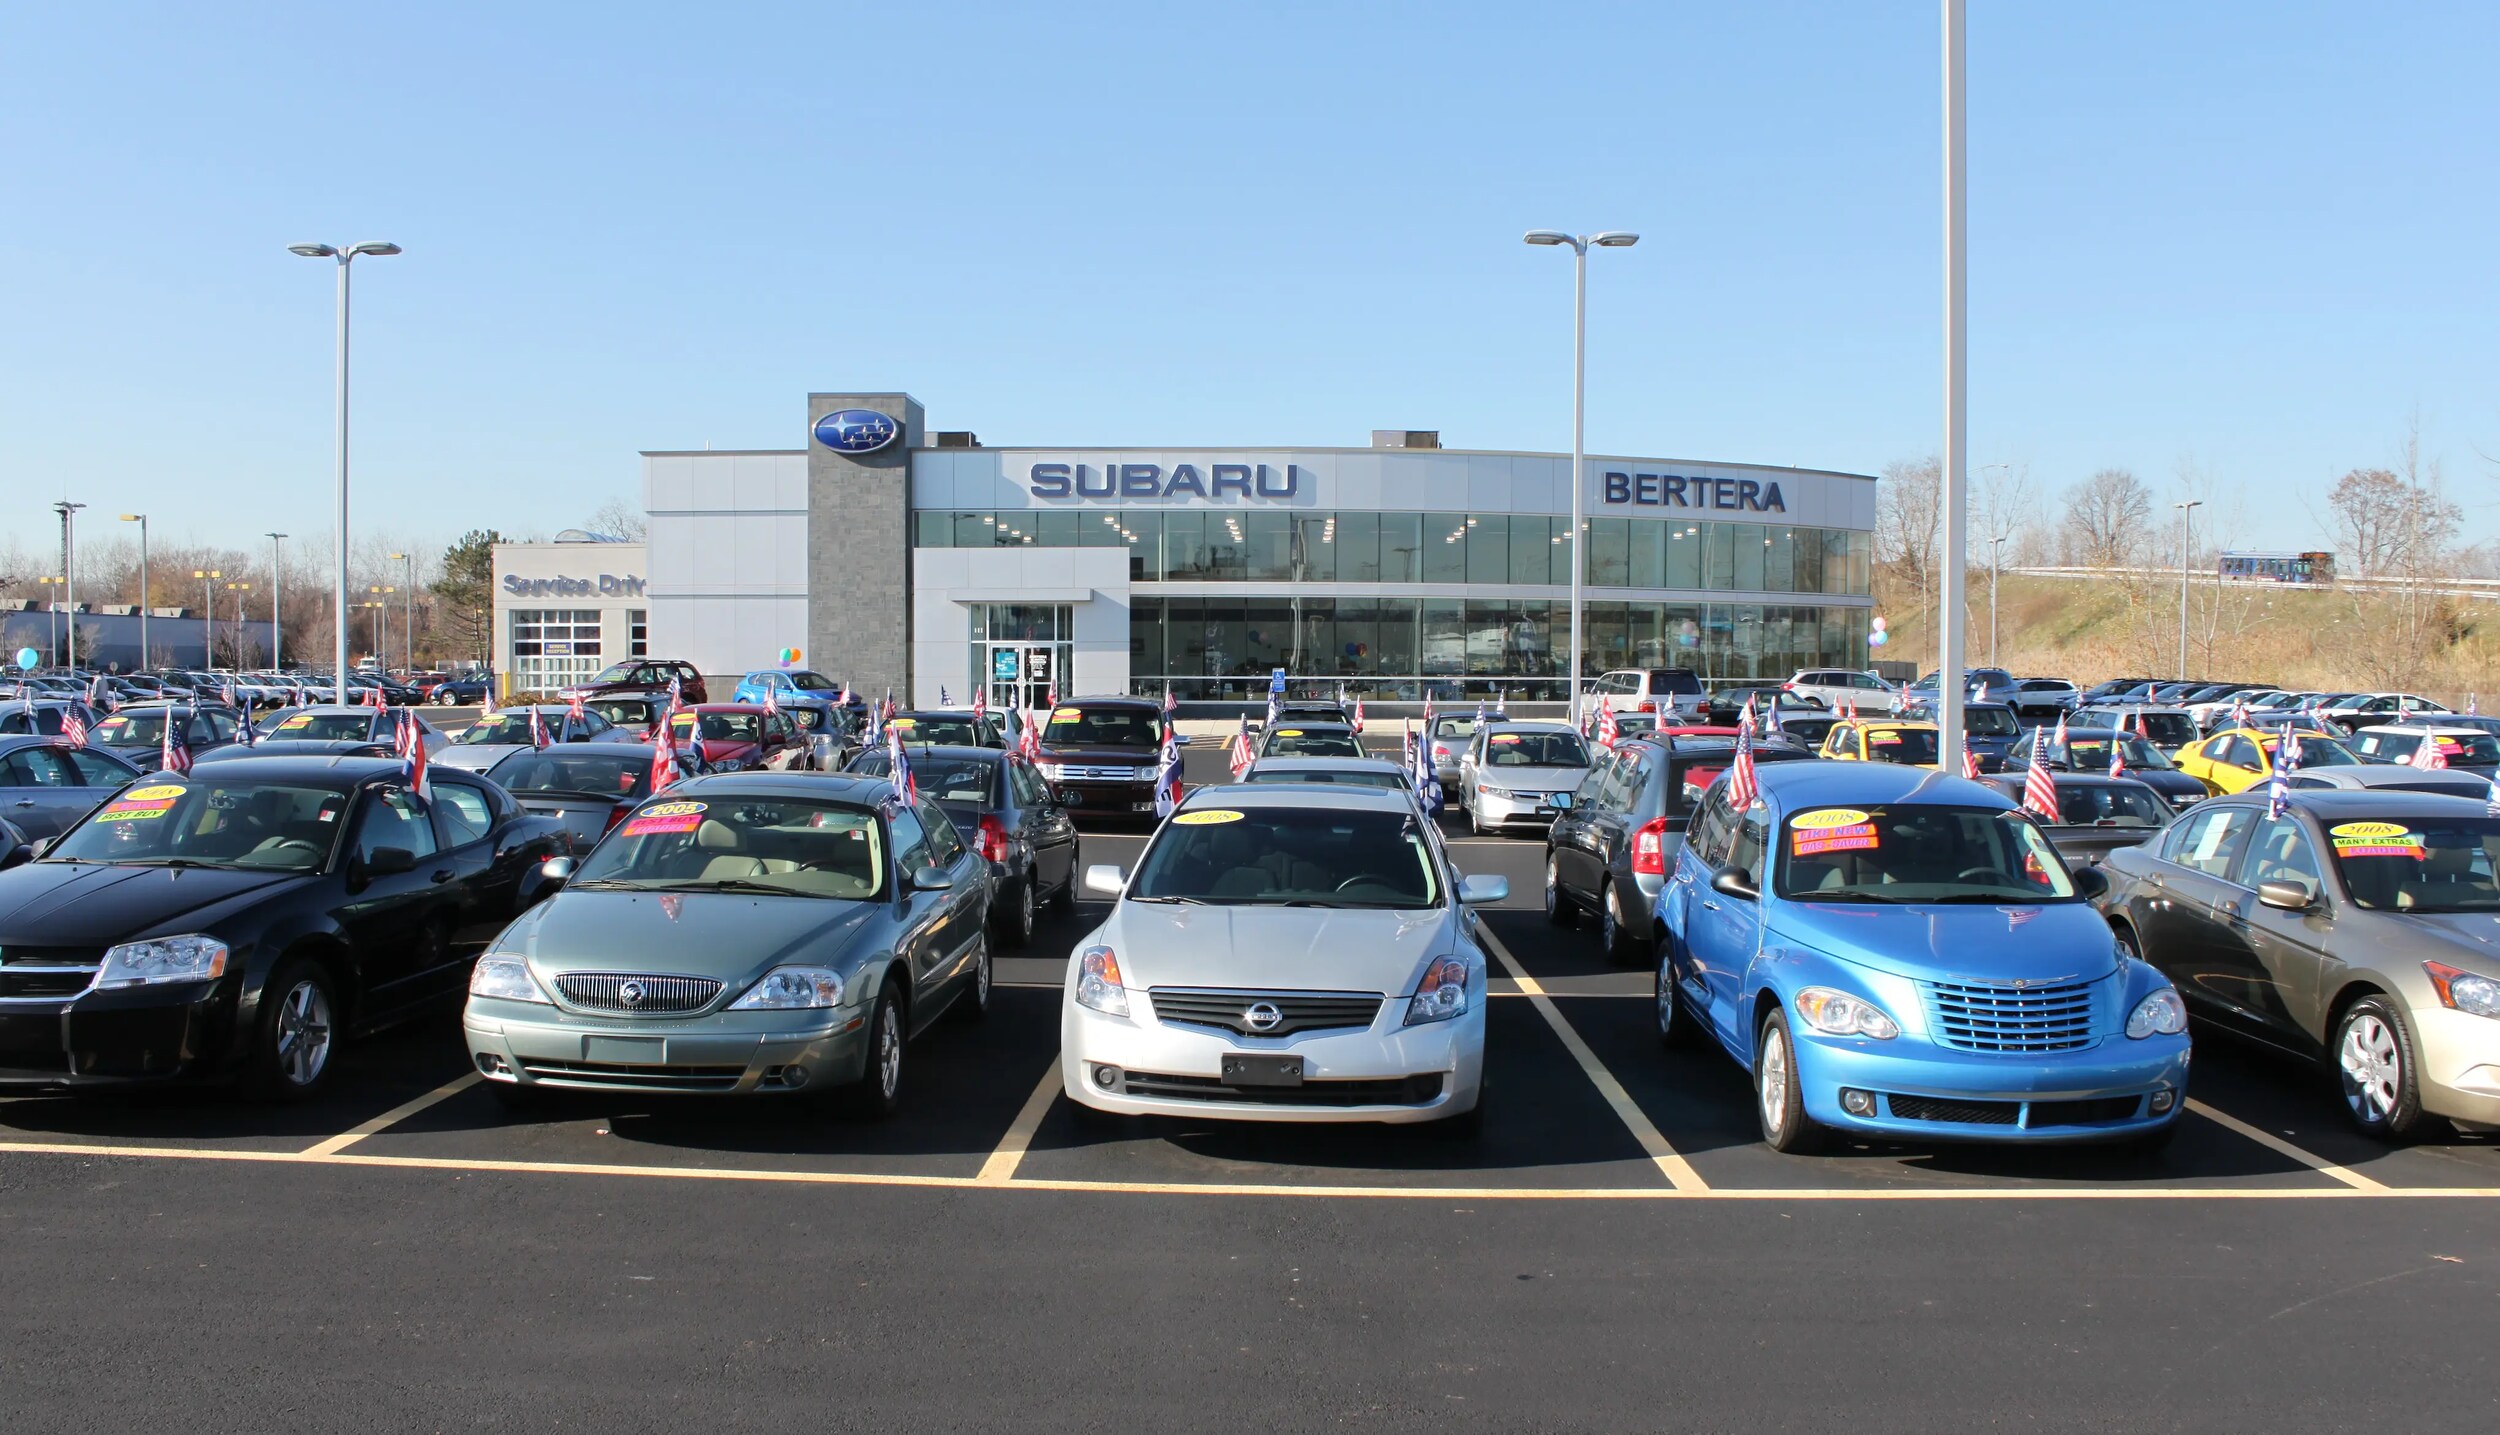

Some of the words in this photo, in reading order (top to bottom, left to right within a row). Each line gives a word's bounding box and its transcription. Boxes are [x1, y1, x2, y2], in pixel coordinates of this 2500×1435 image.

[1031, 463, 1297, 497] SUBARU
[1603, 472, 1786, 512] BERTERA
[503, 574, 591, 593] Service
[101, 812, 131, 821] BEST
[133, 810, 161, 818] BUY
[650, 804, 697, 816] 2005
[1805, 812, 1856, 826] 2008
[1798, 828, 1829, 840] LIKE
[1834, 826, 1868, 837] NEW
[2344, 825, 2394, 835] 2008
[2337, 838, 2366, 846] MANY
[2371, 838, 2413, 846] EXTRAS
